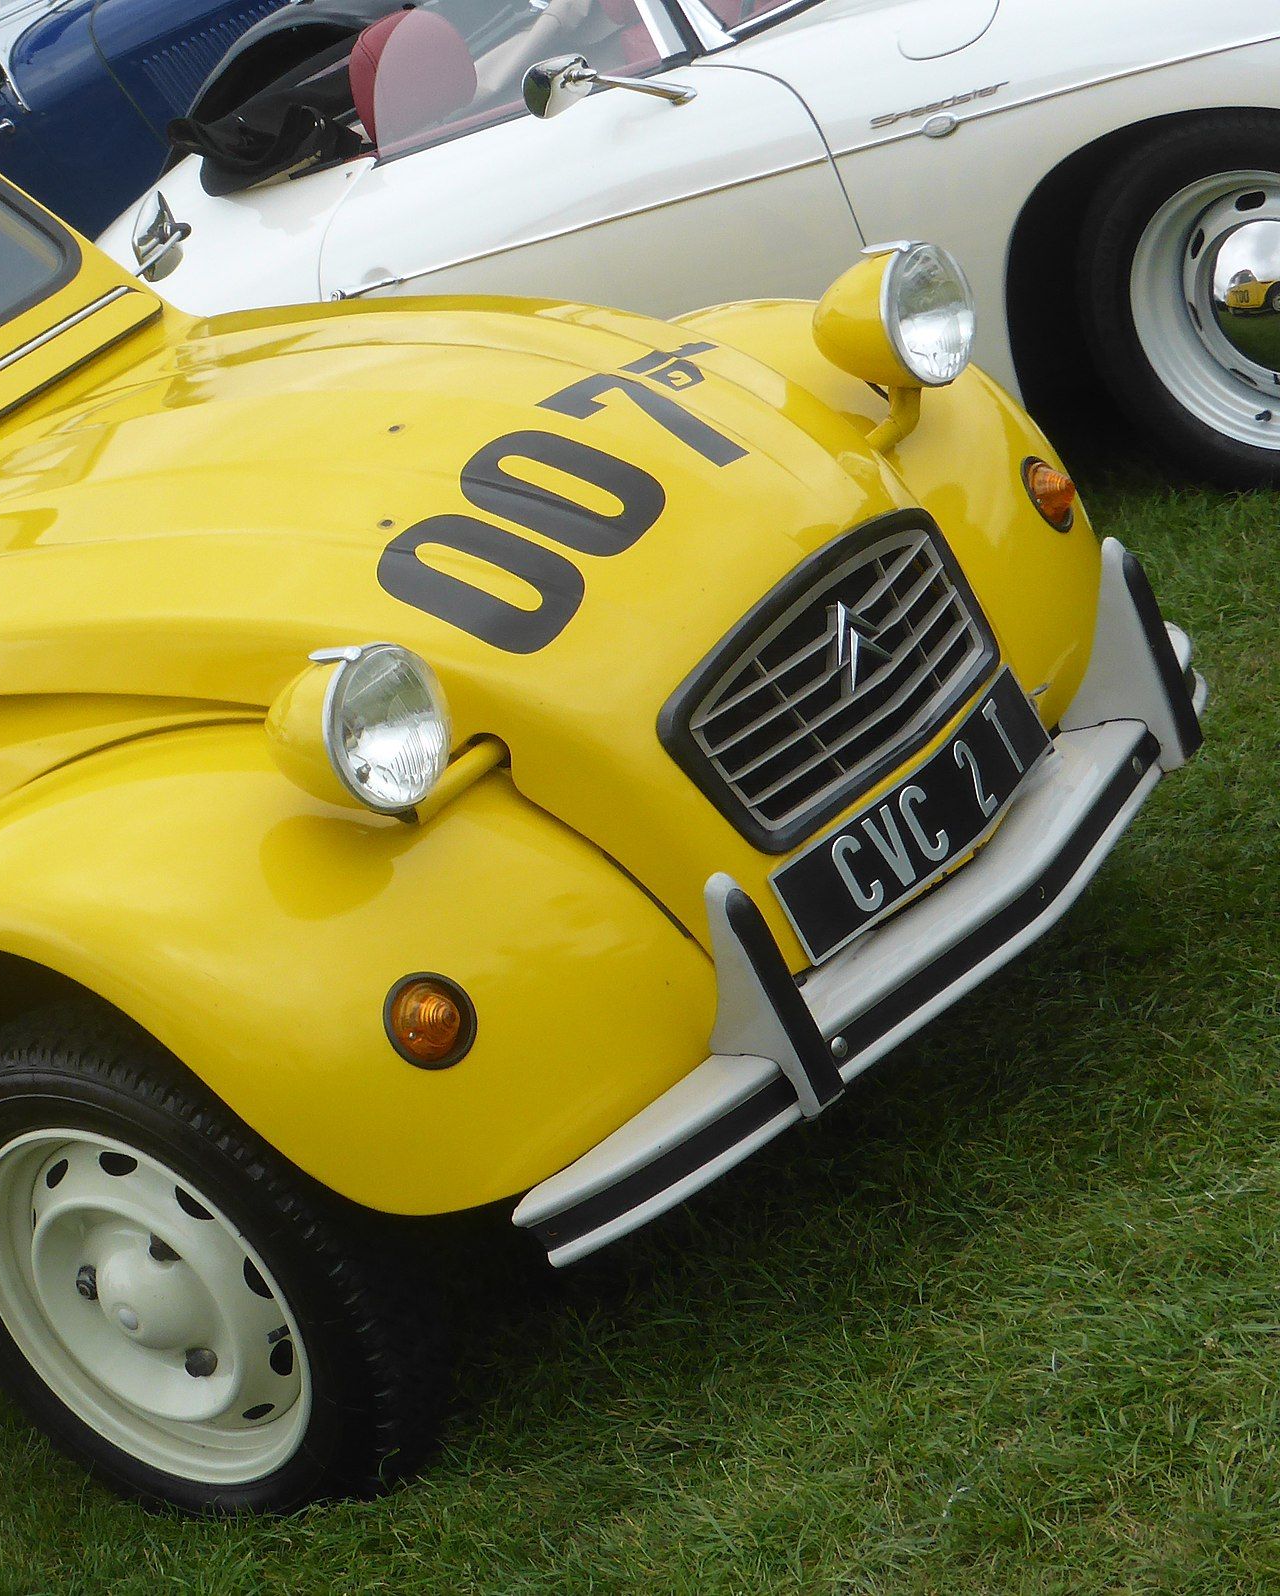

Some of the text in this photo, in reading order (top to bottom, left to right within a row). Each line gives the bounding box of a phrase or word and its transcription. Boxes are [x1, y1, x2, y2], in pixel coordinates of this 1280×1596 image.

[869, 80, 1010, 130] Speedster
[375, 370, 750, 655] 007
[831, 698, 1025, 912] CVC 2 T
